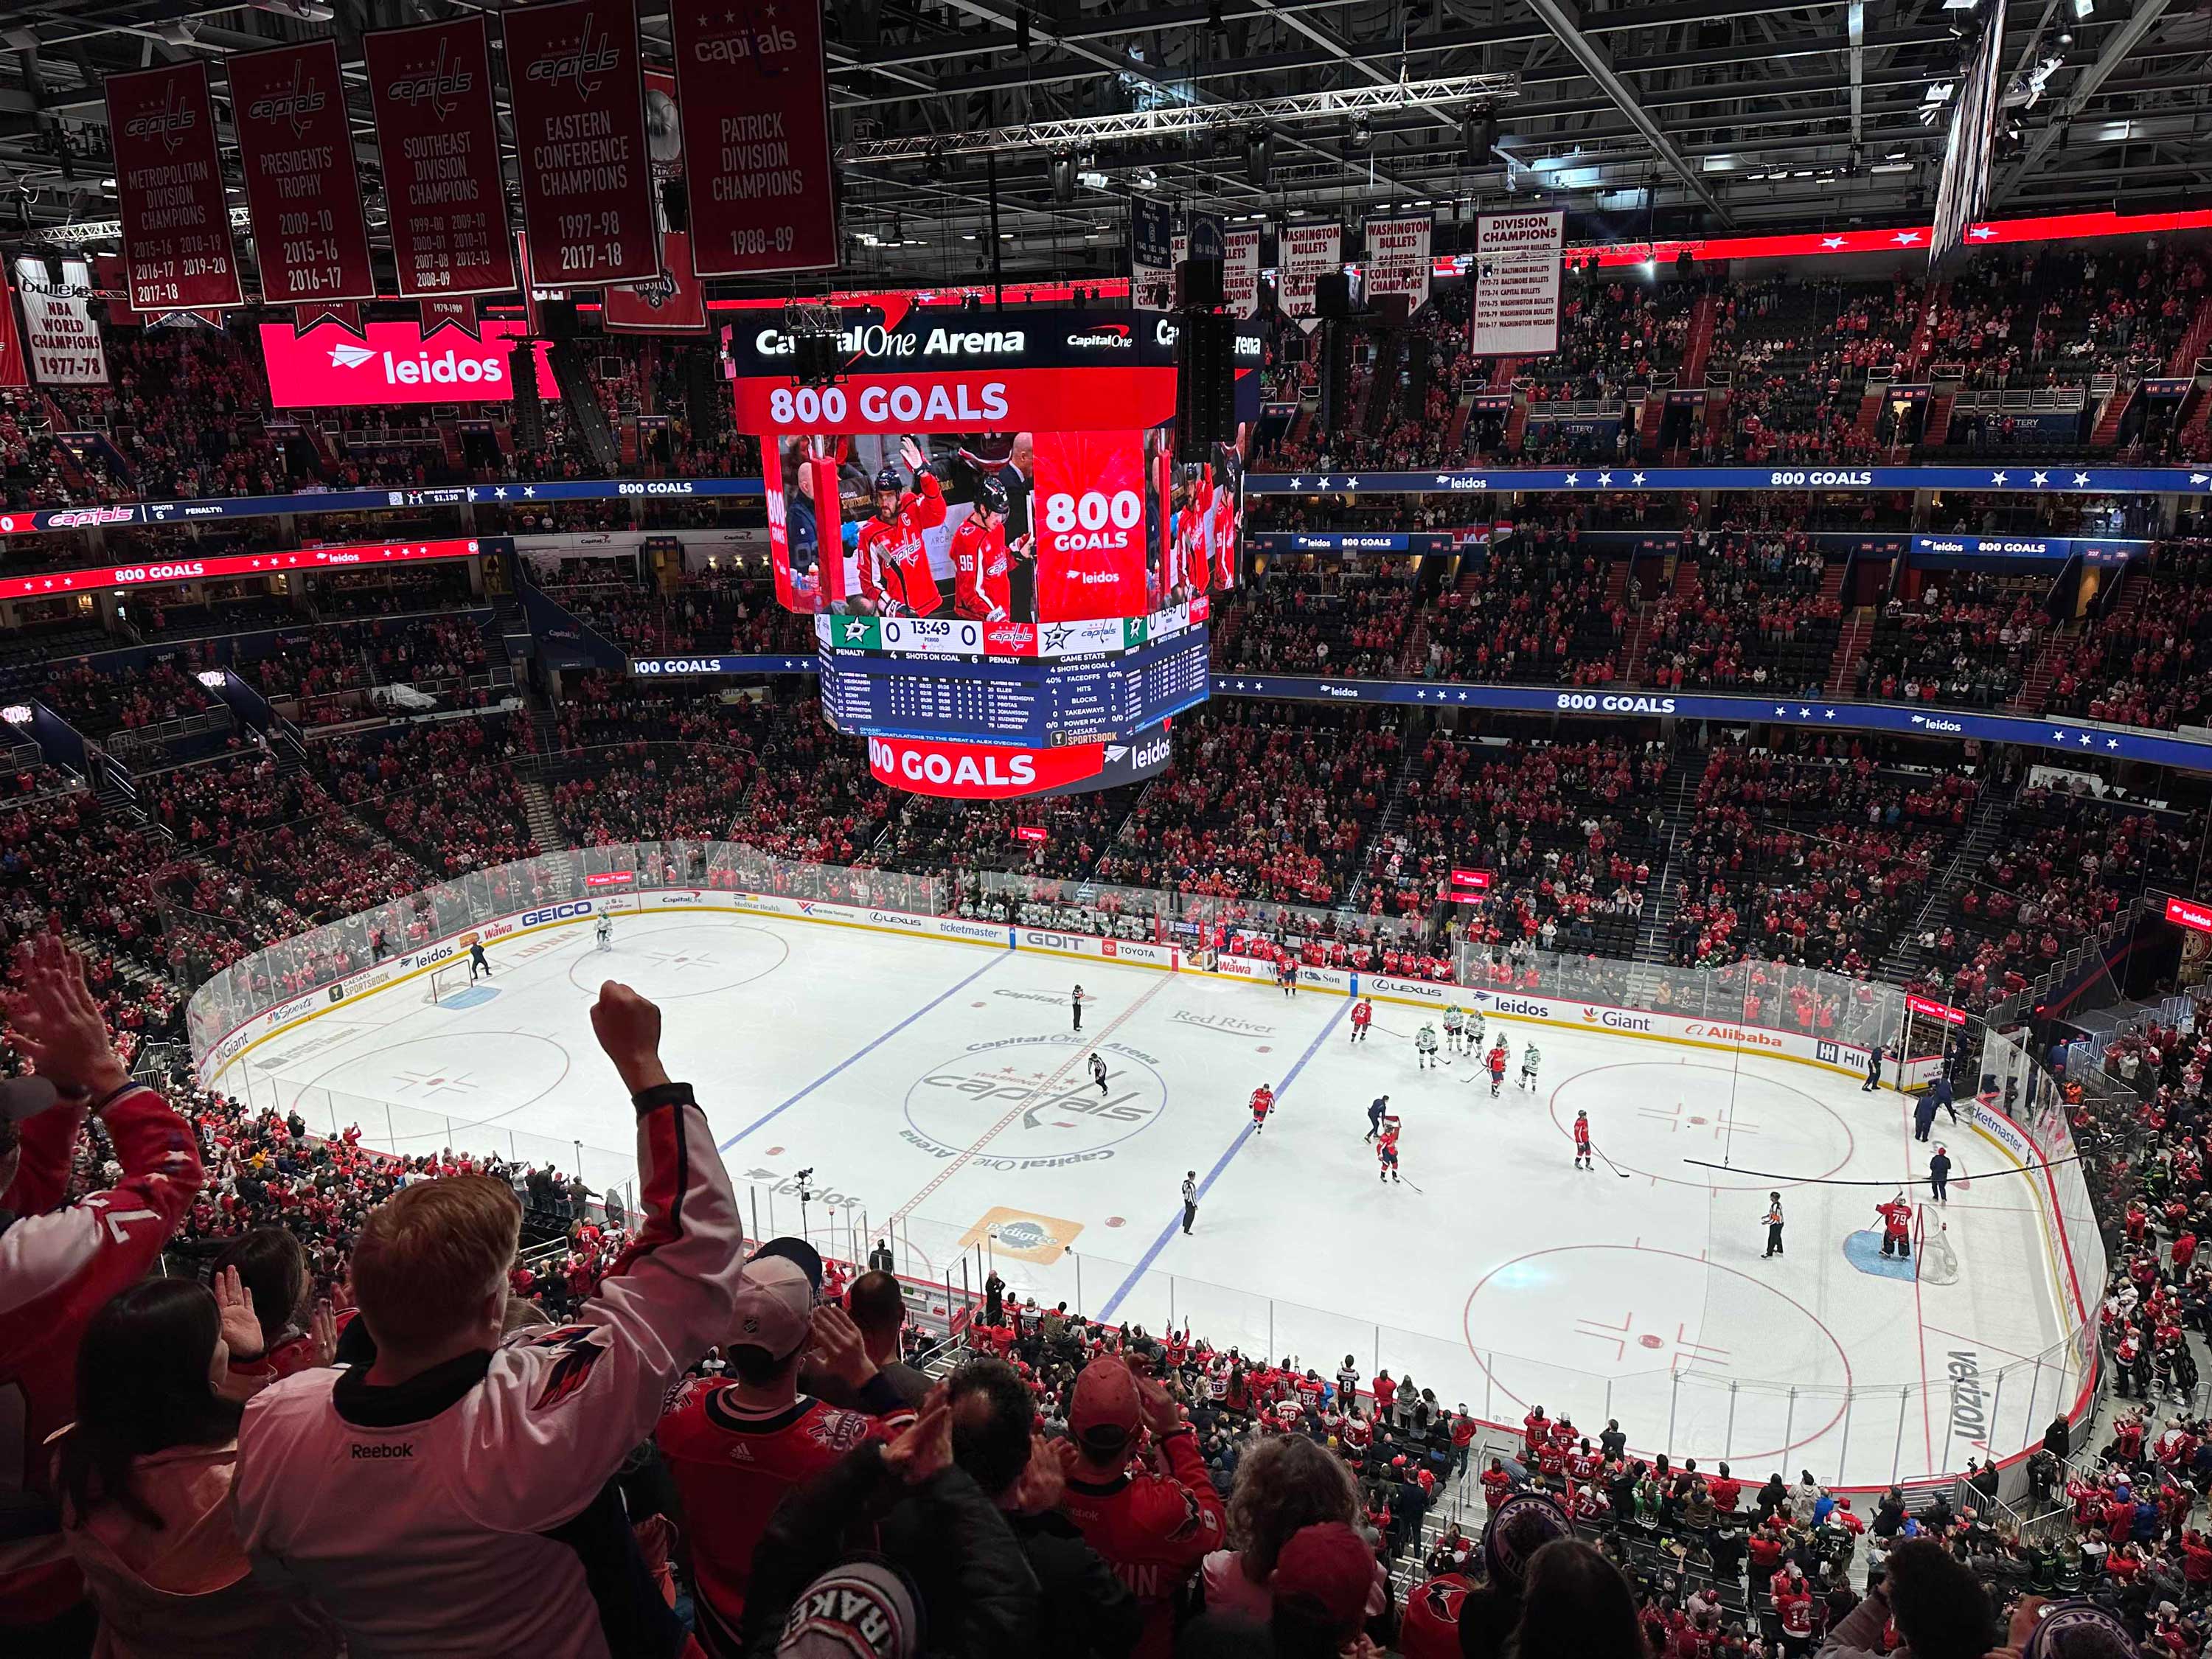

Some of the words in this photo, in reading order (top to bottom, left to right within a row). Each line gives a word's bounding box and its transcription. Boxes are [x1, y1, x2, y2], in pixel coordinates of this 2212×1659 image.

[545, 109, 613, 142] EASTERN
[720, 112, 785, 142] PATRICK
[403, 131, 472, 159] SOUTHEAST
[534, 136, 630, 171] CONFERENCE
[721, 142, 789, 172] DIVISION
[128, 159, 208, 189] METROPOLITAN
[414, 157, 467, 182] DIVISION
[276, 173, 323, 199] TROPHY
[540, 163, 628, 197] CHAMPIONS
[713, 169, 804, 201] CHAMPIONS
[146, 183, 195, 209] DIVISION
[409, 179, 479, 206] CHAMPIONS
[140, 205, 206, 232] CHAMPIONS
[279, 209, 334, 236] 2009-10
[558, 211, 621, 240] 1997-98
[1368, 221, 1430, 236] WASHINGTON
[1492, 216, 1549, 231] DIVISION
[731, 226, 795, 256] 1988-89
[1380, 236, 1417, 249] BULLETS
[1483, 229, 1558, 243] CHAMPIONS
[283, 237, 339, 264] 2015-16
[560, 242, 623, 271] 2017-18
[1292, 241, 1328, 255] BULLETS
[136, 260, 175, 282] 2016-17
[183, 256, 226, 277] 2019-20
[415, 252, 450, 269] 2007-08
[456, 249, 491, 267] 2012-13
[287, 265, 342, 292] 2016-17
[417, 270, 451, 288] 2008-09
[138, 283, 179, 304] 2017-18
[47, 302, 73, 316] NBA
[42, 319, 85, 333] WORLD
[32, 334, 100, 349] CHAMPIONS
[923, 329, 1024, 355] Arena
[41, 357, 101, 375] 1977-78
[383, 347, 504, 385] leidos
[770, 388, 848, 425] 800
[860, 382, 1009, 422] GOALS
[618, 482, 644, 494] 800
[647, 481, 693, 494] GOALS
[1450, 475, 1487, 490] leidos
[1770, 471, 1804, 485] 800
[1809, 470, 1872, 485] GOALS
[152, 504, 174, 512] SHOTS
[434, 493, 459, 503] $1,130
[48, 506, 134, 529] capitals
[156, 511, 164, 520] 6
[1046, 490, 1141, 533] 800
[1054, 532, 1128, 552] GOALS
[1307, 538, 1332, 548] leidos
[1341, 538, 1359, 547] 800
[1360, 538, 1391, 547] GOALS
[1932, 540, 1964, 553] leidos
[1978, 542, 2002, 552] 800
[2003, 542, 2046, 554] GOALS
[114, 568, 146, 582] 800
[149, 563, 204, 580] GOALS
[329, 551, 360, 563] leidos
[959, 554, 974, 572] 96
[1082, 571, 1120, 584] leidos
[886, 622, 900, 642] 0
[911, 621, 950, 636] 13:49
[961, 625, 976, 646] 0
[664, 659, 722, 672] GOALS
[836, 649, 865, 657] PENALTY
[906, 653, 928, 661] SHOTS
[971, 655, 978, 664] 6
[989, 657, 1020, 665] PENALTY
[1060, 654, 1082, 663] GAME
[1083, 653, 1106, 661] STATS
[1046, 676, 1062, 684] 40%
[1067, 673, 1101, 683] FACEOFFS
[1107, 671, 1122, 679] 60%
[1057, 665, 1079, 673] SHOTS
[1077, 685, 1092, 693] HITS
[1071, 695, 1098, 704] BLOCKS
[1331, 685, 1358, 698] leidos
[1557, 692, 1597, 710] 800
[1601, 695, 1676, 714] GOALS
[1924, 717, 1962, 733] leidos
[1064, 706, 1105, 717] TAKEAWAYS
[1064, 719, 1089, 728] POWER
[1089, 717, 1107, 726] PLAY
[1067, 727, 1097, 736] CAESARS
[1067, 731, 1118, 746] SPORTSBOOK
[1132, 737, 1171, 771] leidos
[901, 754, 1037, 785] GOALS
[223, 1031, 249, 1060] Giant
[279, 996, 313, 1019] Sports
[344, 970, 392, 998] SPORTSBOOK
[415, 945, 453, 970] leidos
[484, 922, 513, 941] Wawa
[521, 901, 592, 928] GEICO
[733, 900, 759, 911] MedStar
[759, 902, 781, 913] Health
[883, 914, 922, 927] LEXUS
[939, 922, 999, 939] ticketmaster
[1026, 931, 1085, 950] GDIT
[1120, 946, 1155, 959] TOYOTA
[1219, 960, 1252, 975] Wawa
[1322, 973, 1340, 984] Son
[1391, 982, 1442, 997] LEXUS
[1495, 996, 1549, 1019] leidos
[1601, 1010, 1651, 1032] Giant
[1705, 1026, 1782, 1048] Alibaba
[1172, 1009, 1220, 1028] Red
[1221, 1016, 1277, 1036] River
[965, 1034, 1047, 1053] Capital
[1049, 1033, 1088, 1045] One
[1104, 1042, 1161, 1066] Arena
[1892, 1213, 1907, 1226] 79
[984, 1220, 1059, 1246] Pedigree
[1947, 1351, 1992, 1441] verizon
[351, 1443, 414, 1459] Reebok
[1578, 1500, 1598, 1516] 77
[1792, 1608, 1812, 1628] 14
